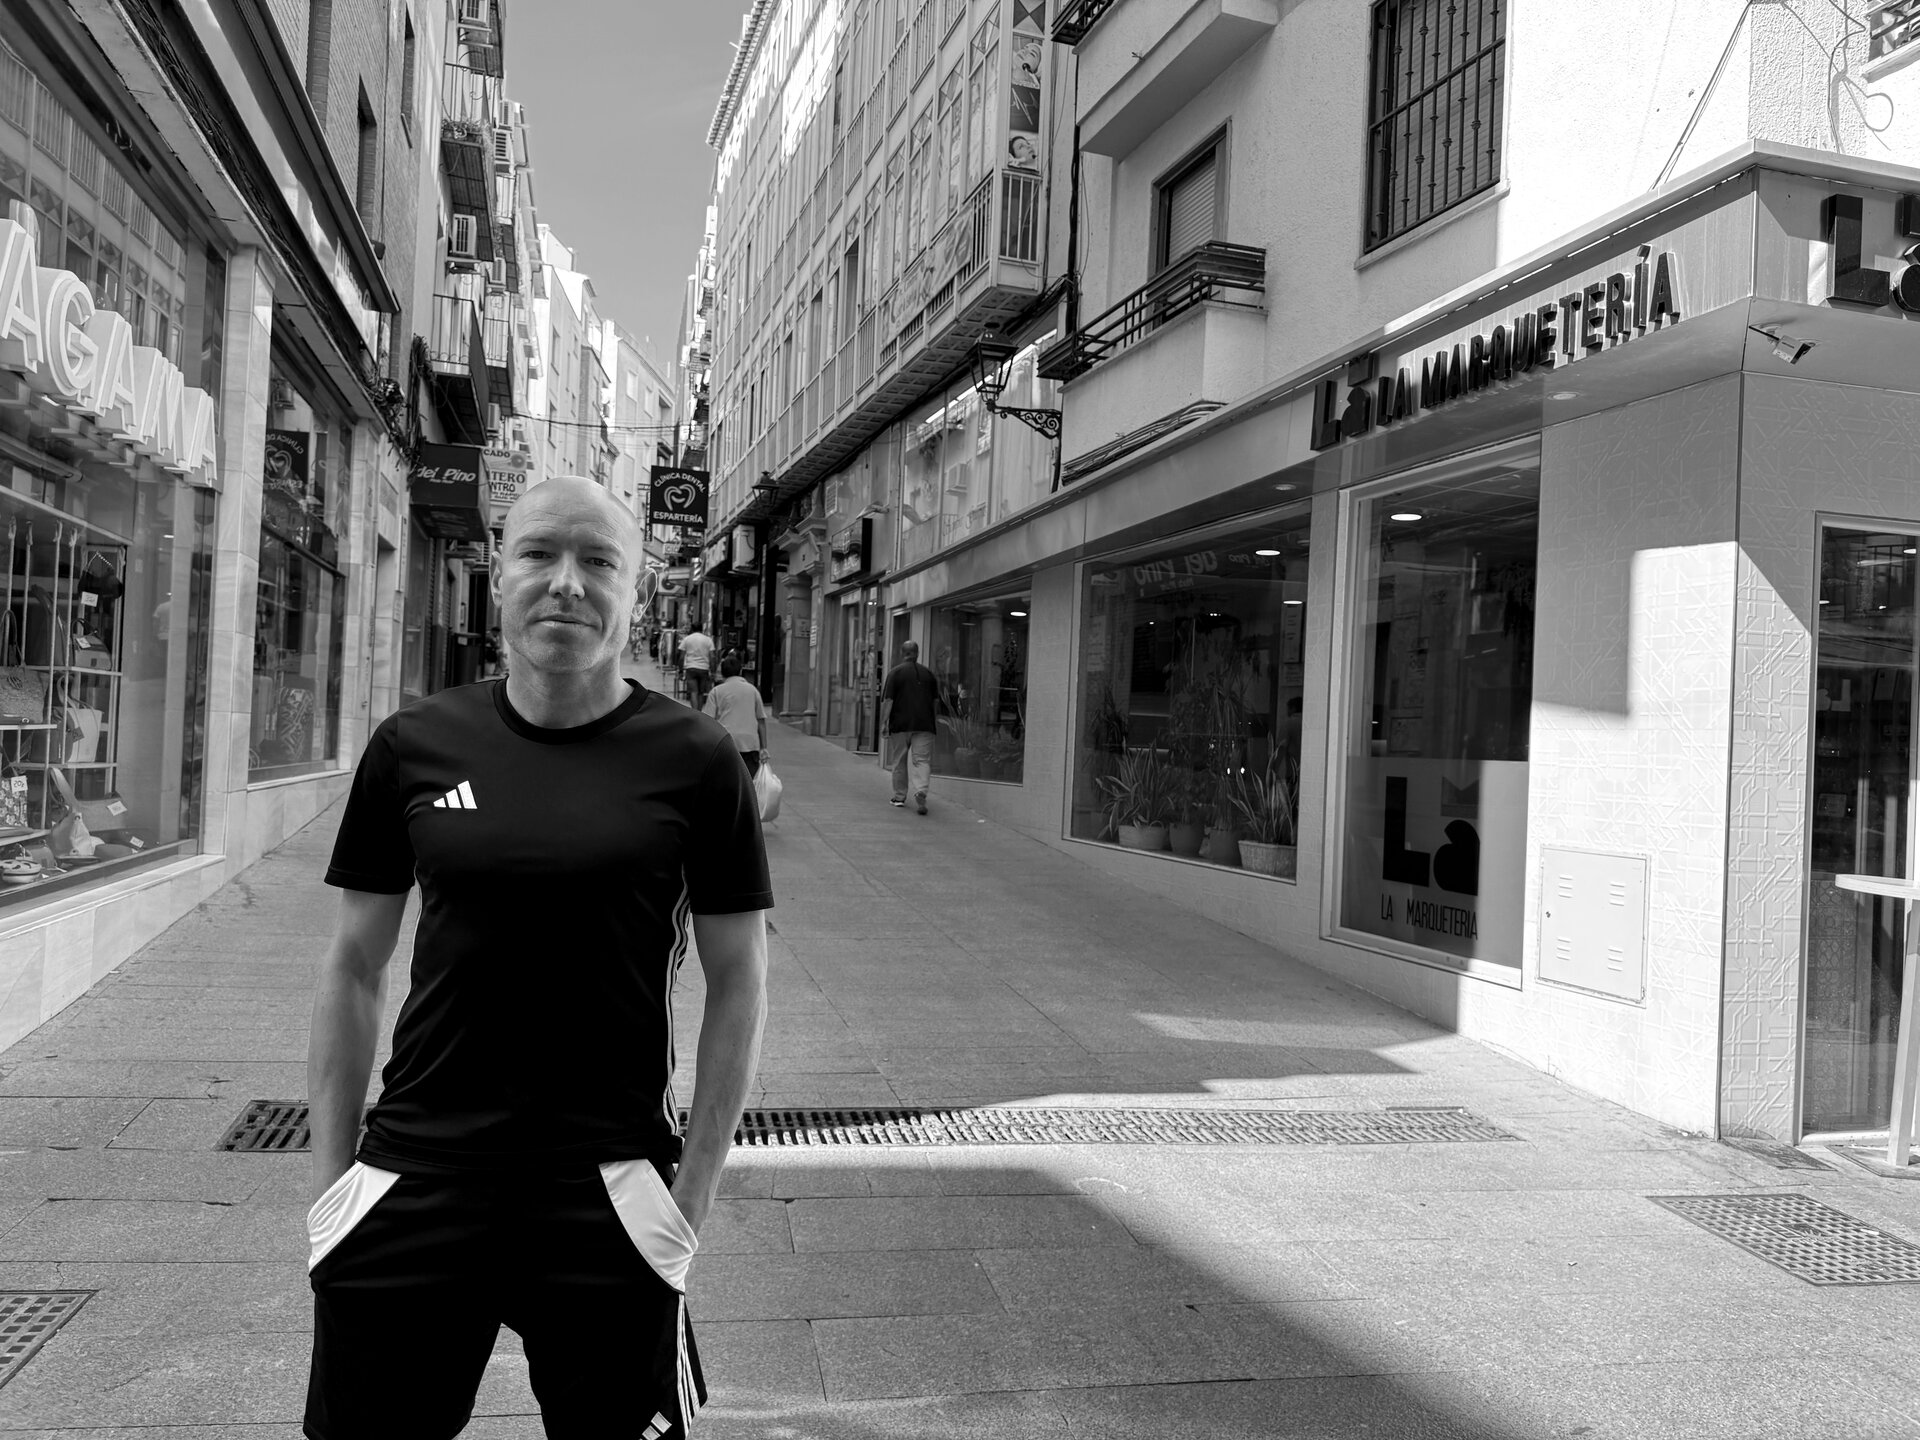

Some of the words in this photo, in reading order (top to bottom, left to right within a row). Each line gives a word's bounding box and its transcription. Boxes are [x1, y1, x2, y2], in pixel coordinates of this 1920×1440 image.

[1420, 244, 1681, 409] MARQUETERÍA
[443, 469, 476, 482] Pino
[682, 473, 706, 493] DENTAL
[653, 511, 704, 524] ESPARTERÍA
[1381, 893, 1394, 922] LA
